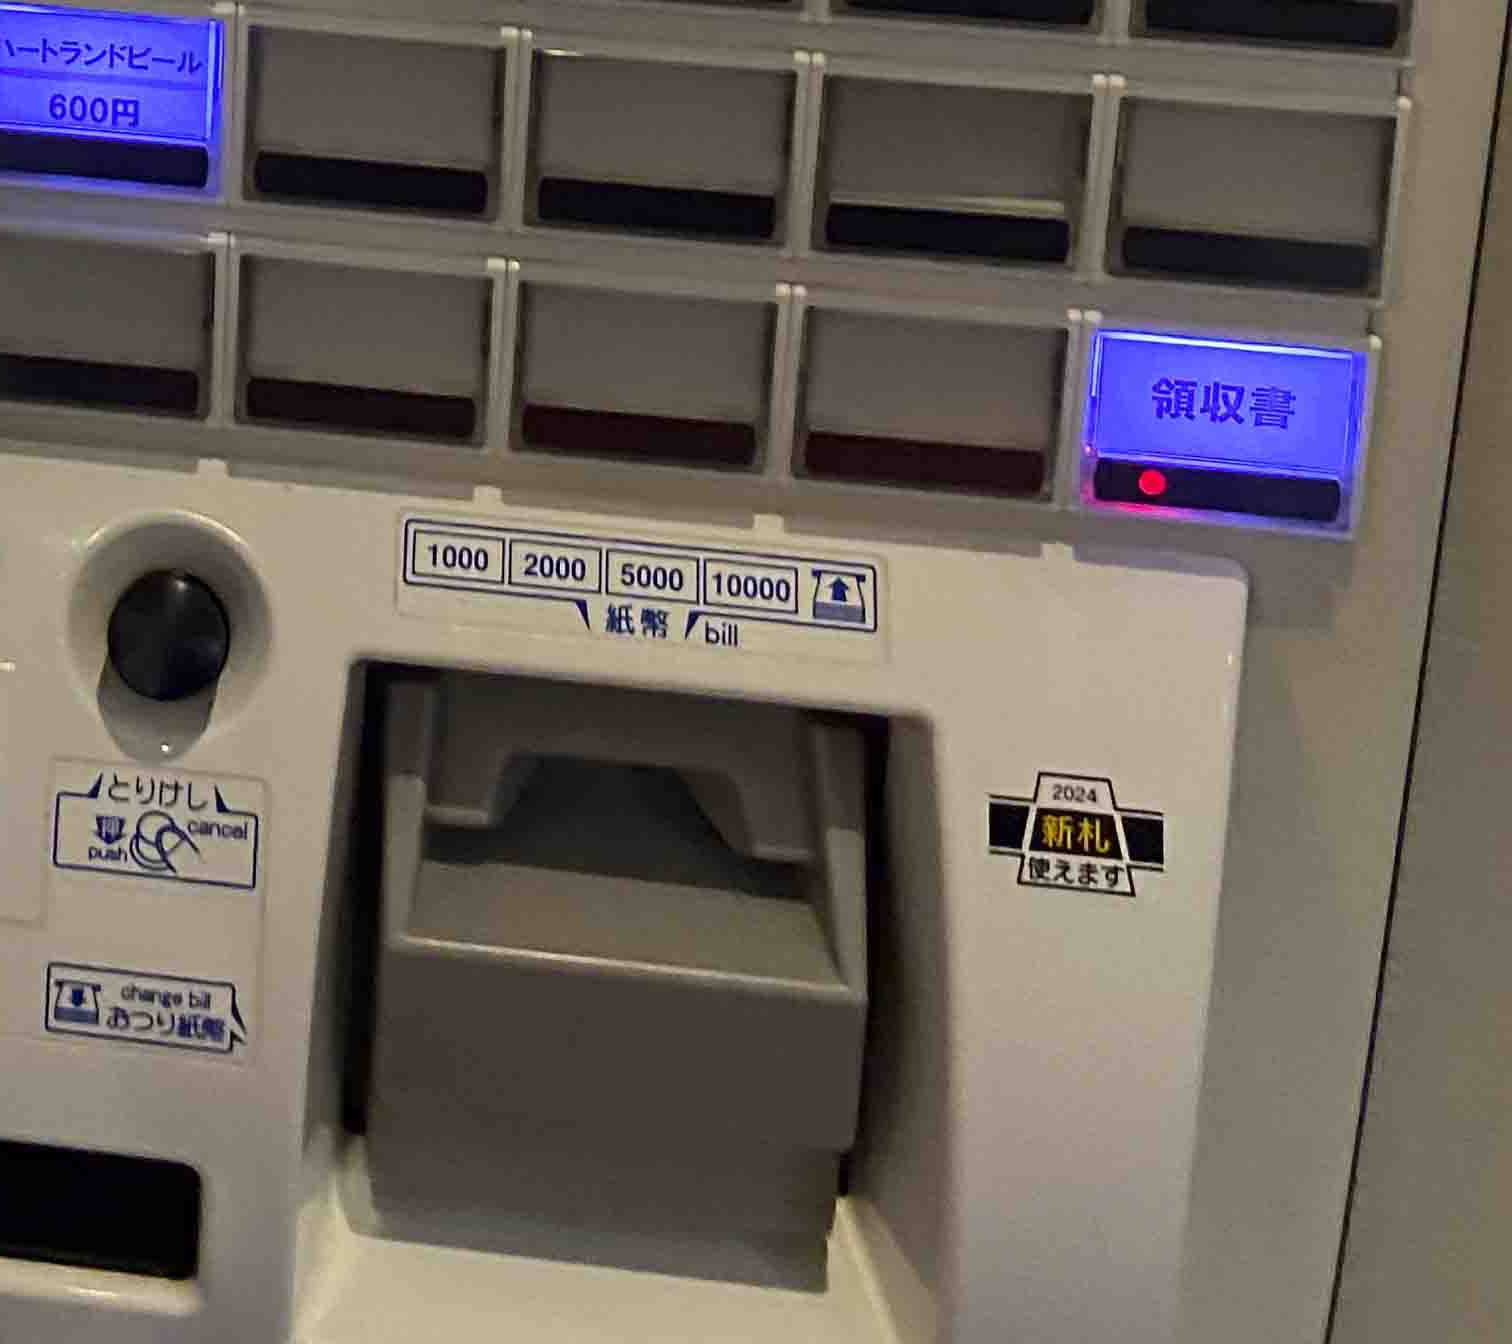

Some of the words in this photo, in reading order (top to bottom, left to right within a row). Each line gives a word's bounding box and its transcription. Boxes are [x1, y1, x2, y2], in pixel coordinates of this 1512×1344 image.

[49, 93, 140, 127] 600円
[1151, 376, 1297, 430] 領収書
[427, 543, 489, 571] 1000
[523, 553, 587, 581] 2000
[620, 563, 684, 592] 5000
[713, 572, 791, 603] 10000
[605, 602, 670, 640] 紙幣
[704, 620, 739, 647] bill
[108, 772, 209, 811] とりけし
[1052, 783, 1098, 804] 2024
[187, 818, 248, 841] cancel
[1041, 814, 1112, 854] 新札
[88, 845, 128, 863] push
[1029, 855, 1125, 888] 使えます
